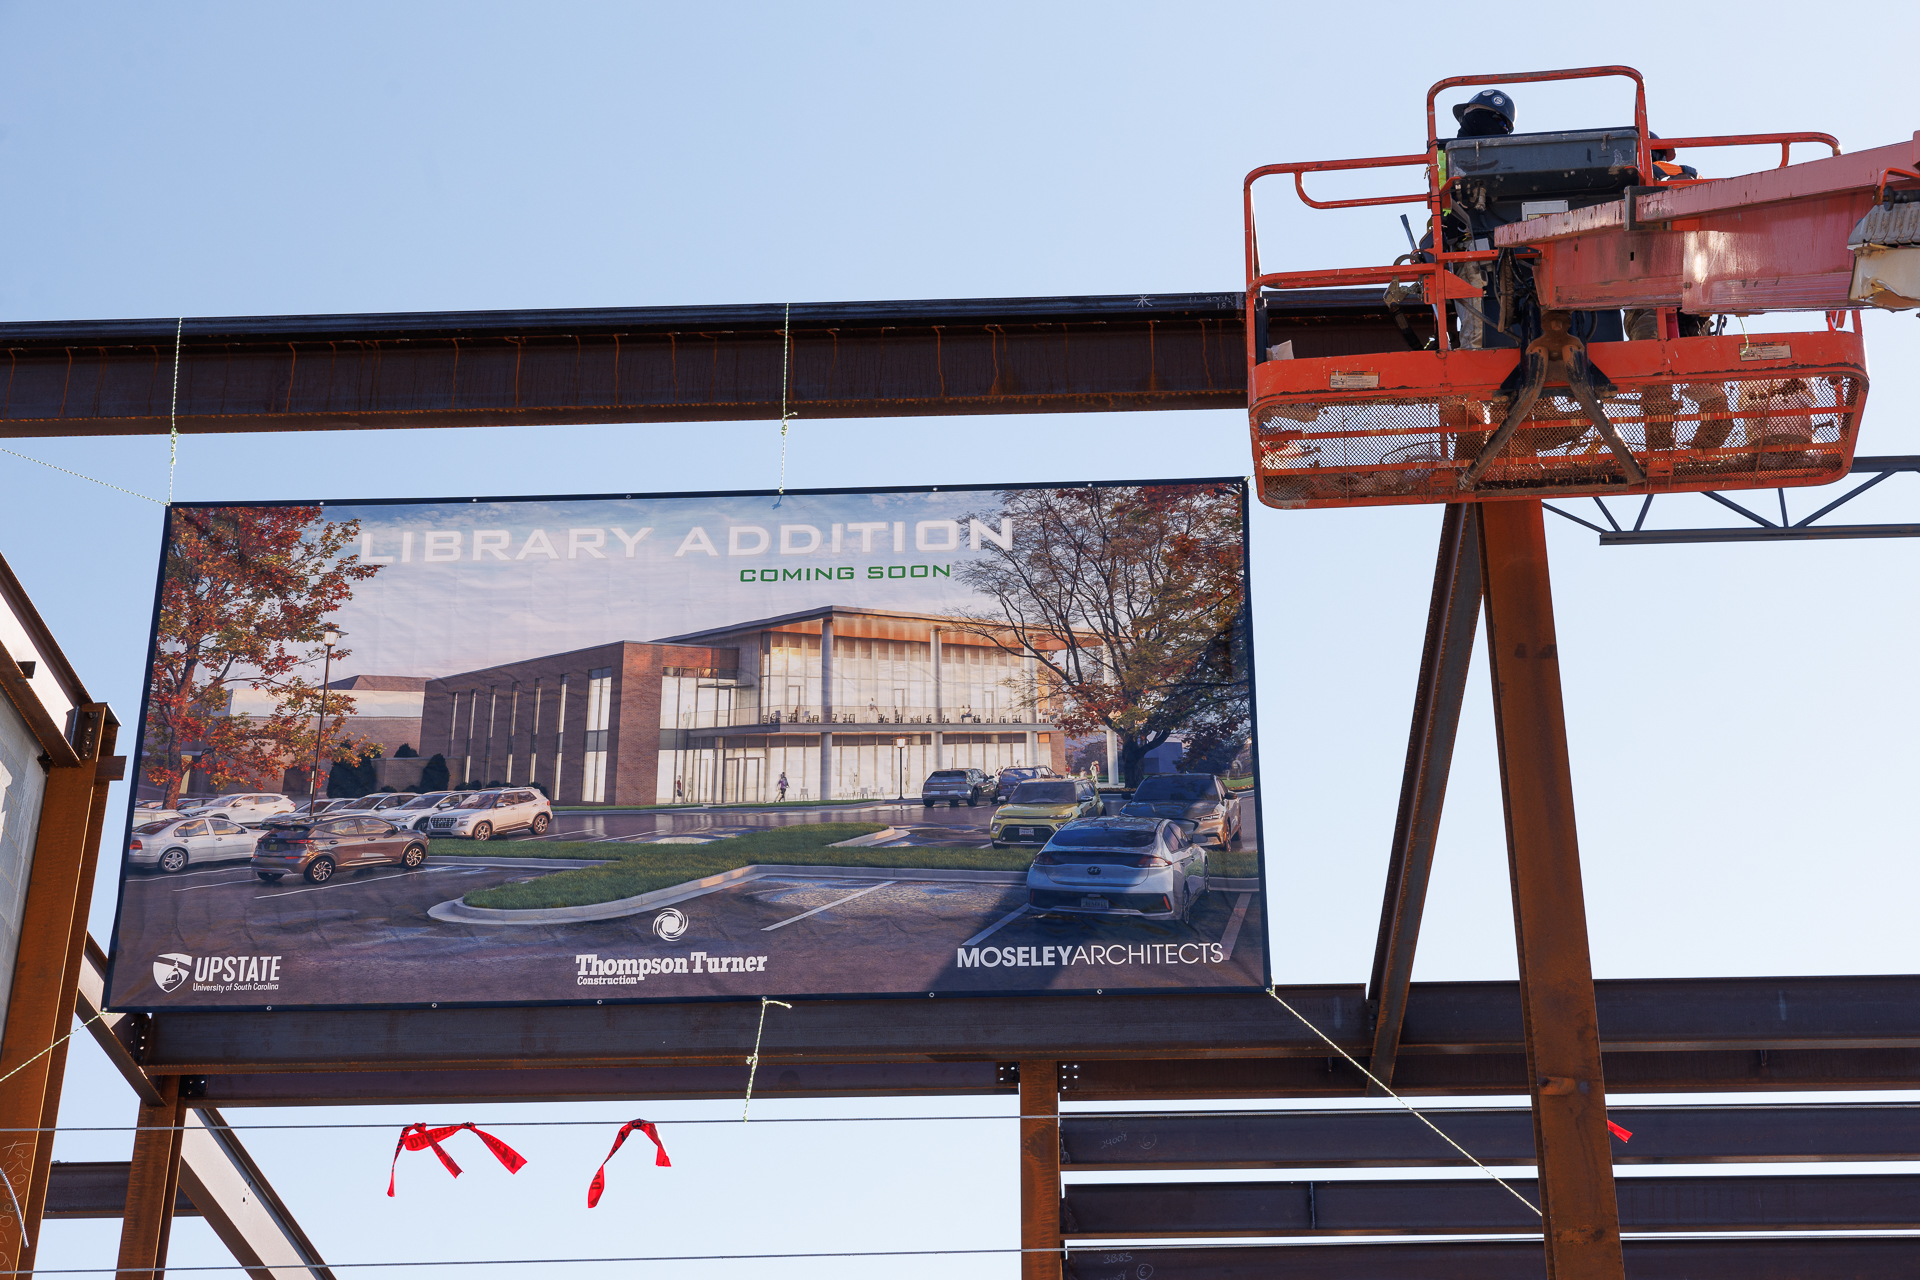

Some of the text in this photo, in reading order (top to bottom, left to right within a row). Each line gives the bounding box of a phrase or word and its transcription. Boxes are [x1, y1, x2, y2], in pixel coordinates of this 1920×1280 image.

[360, 517, 1013, 564] LIBRARY ADDITION
[740, 564, 951, 582] COMING SOON
[194, 956, 282, 982] UPSTATE
[575, 951, 767, 980] Thompson Turner
[192, 983, 225, 993] University
[225, 983, 232, 991] of
[233, 983, 252, 991] South
[577, 975, 638, 986] Construction
